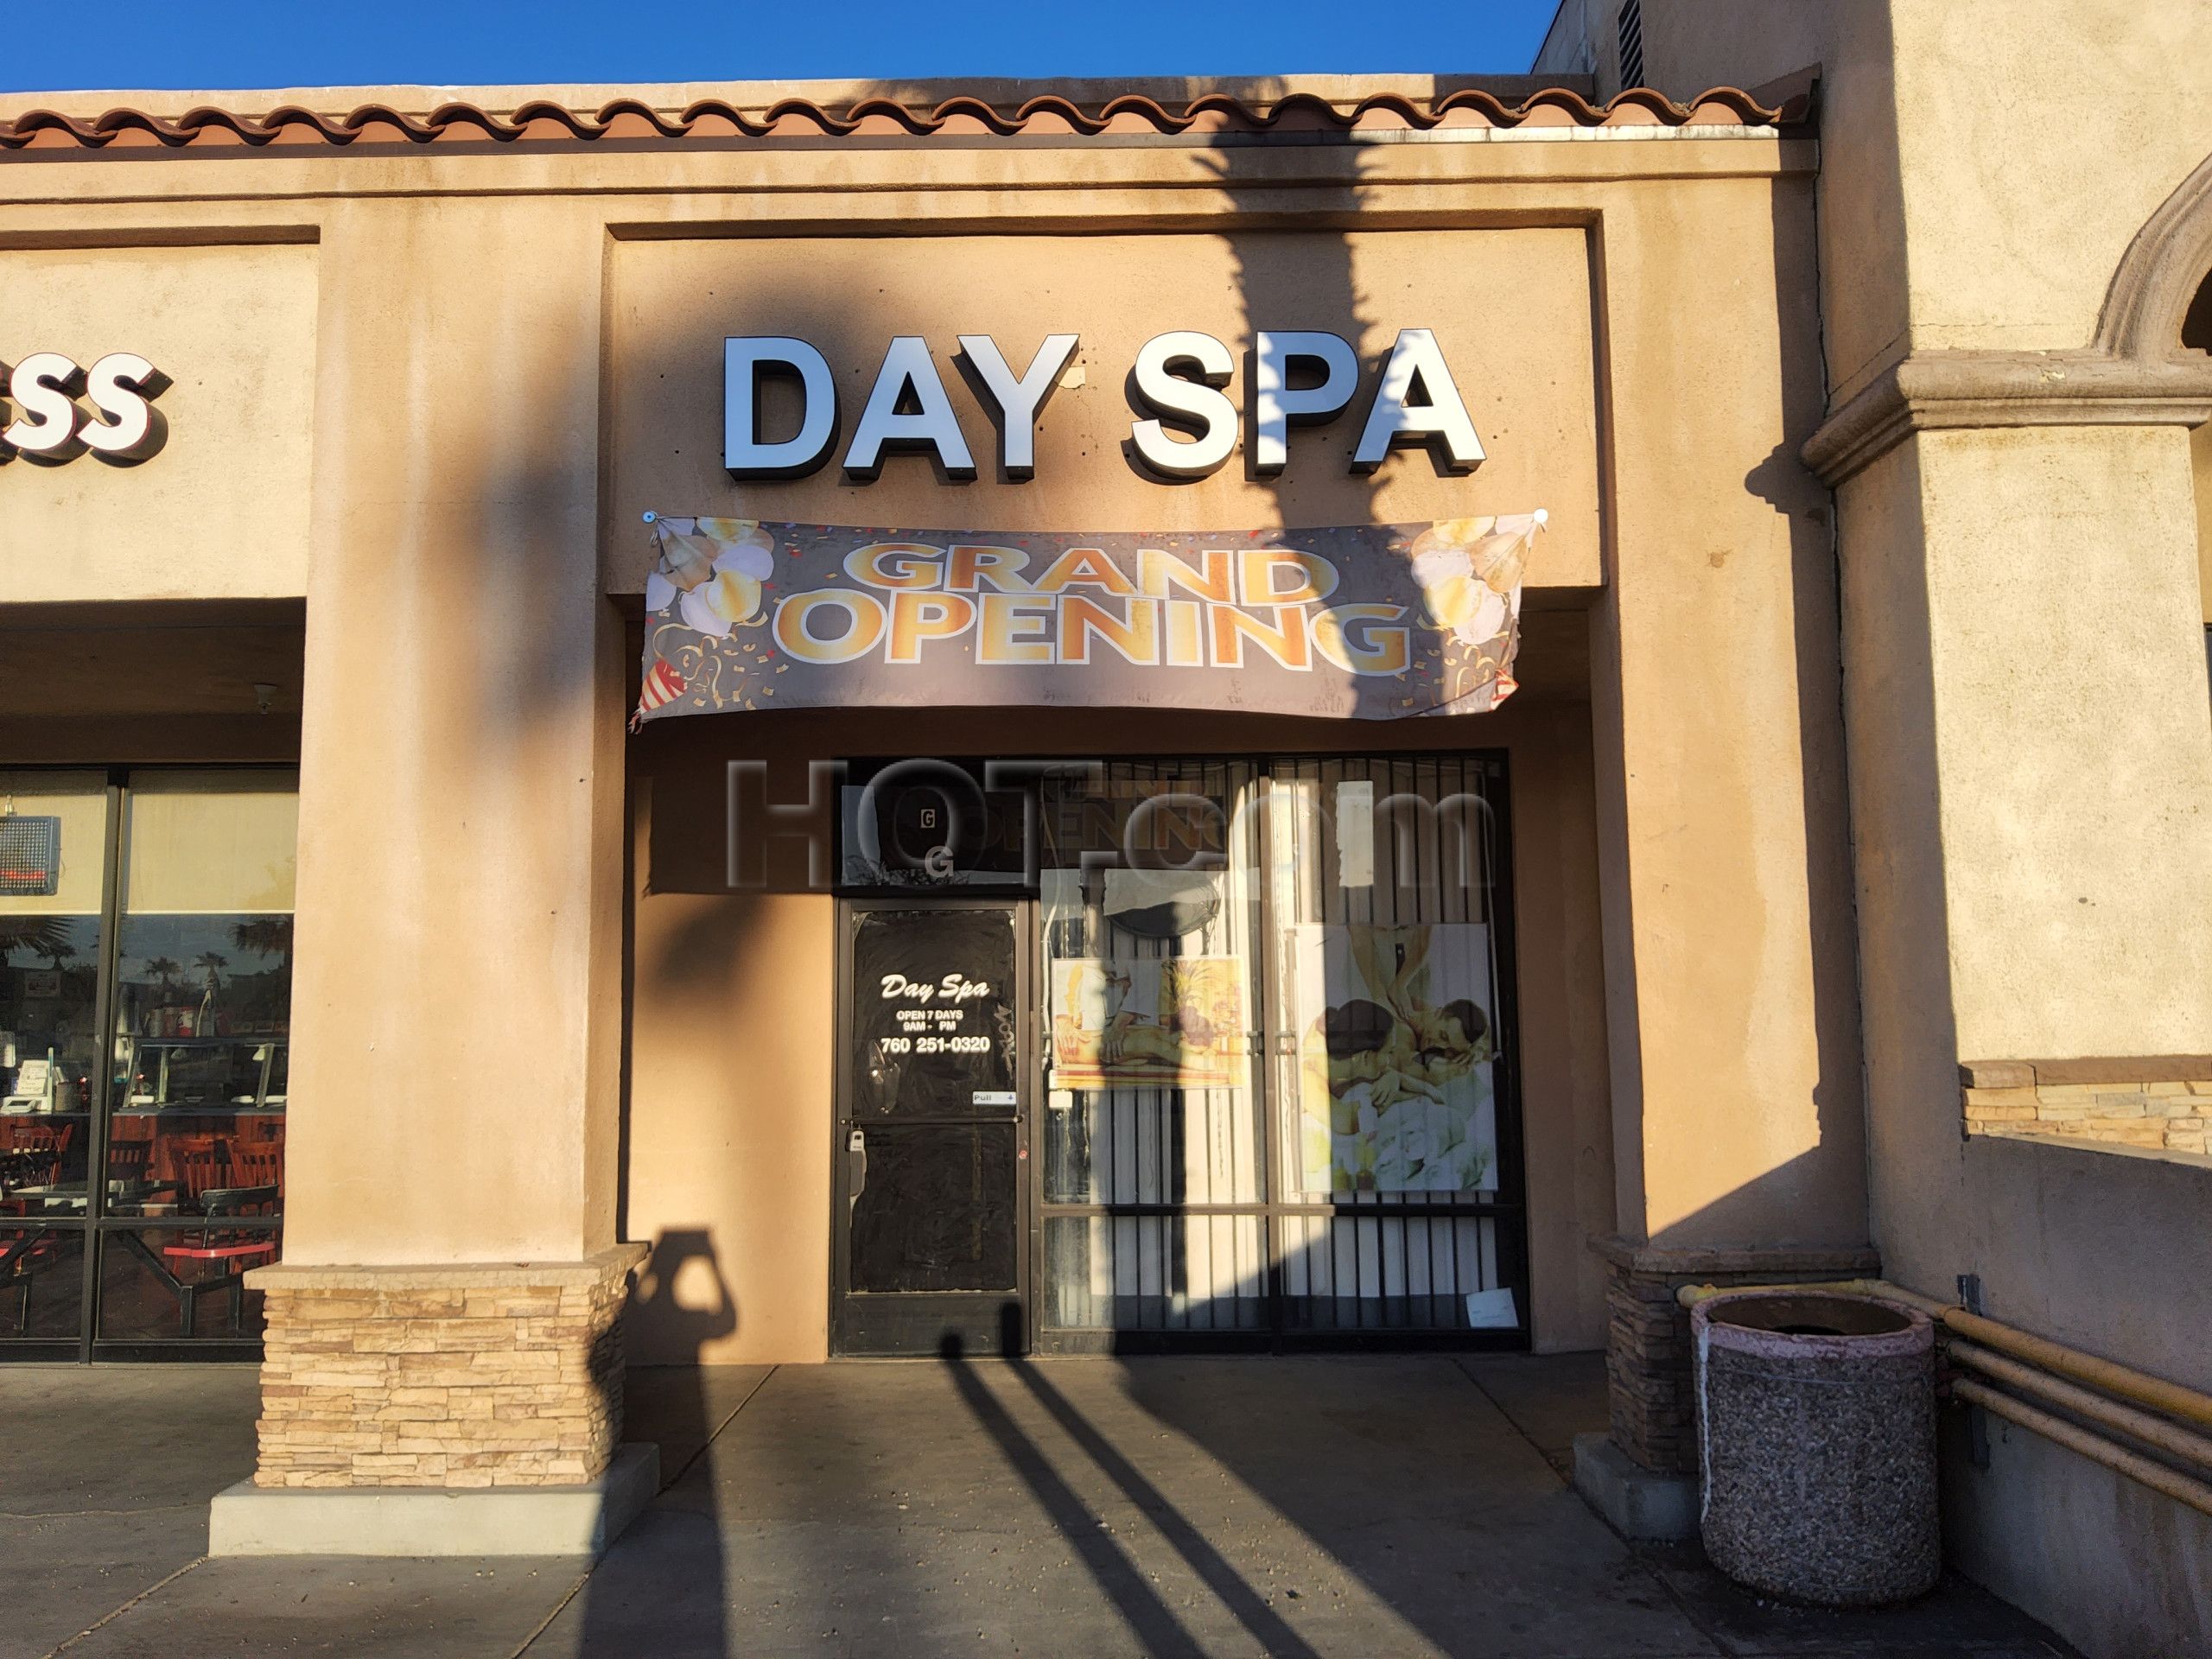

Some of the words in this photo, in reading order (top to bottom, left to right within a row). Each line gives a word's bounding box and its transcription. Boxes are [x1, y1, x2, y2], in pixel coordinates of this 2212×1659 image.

[0, 352, 162, 456] SS
[724, 334, 1080, 474] DAY
[1128, 328, 1487, 473] SPA
[843, 543, 1340, 605] GRAND
[772, 588, 1413, 677] OPENING
[925, 845, 954, 878] G
[880, 974, 934, 1004] Day
[938, 973, 990, 1004] Spa
[896, 1010, 925, 1020] OPEN
[927, 1010, 934, 1020] 7
[935, 1009, 963, 1020] DAYS
[938, 1020, 957, 1031] PM
[880, 1038, 911, 1053] 760
[916, 1037, 991, 1053] 251-0320
